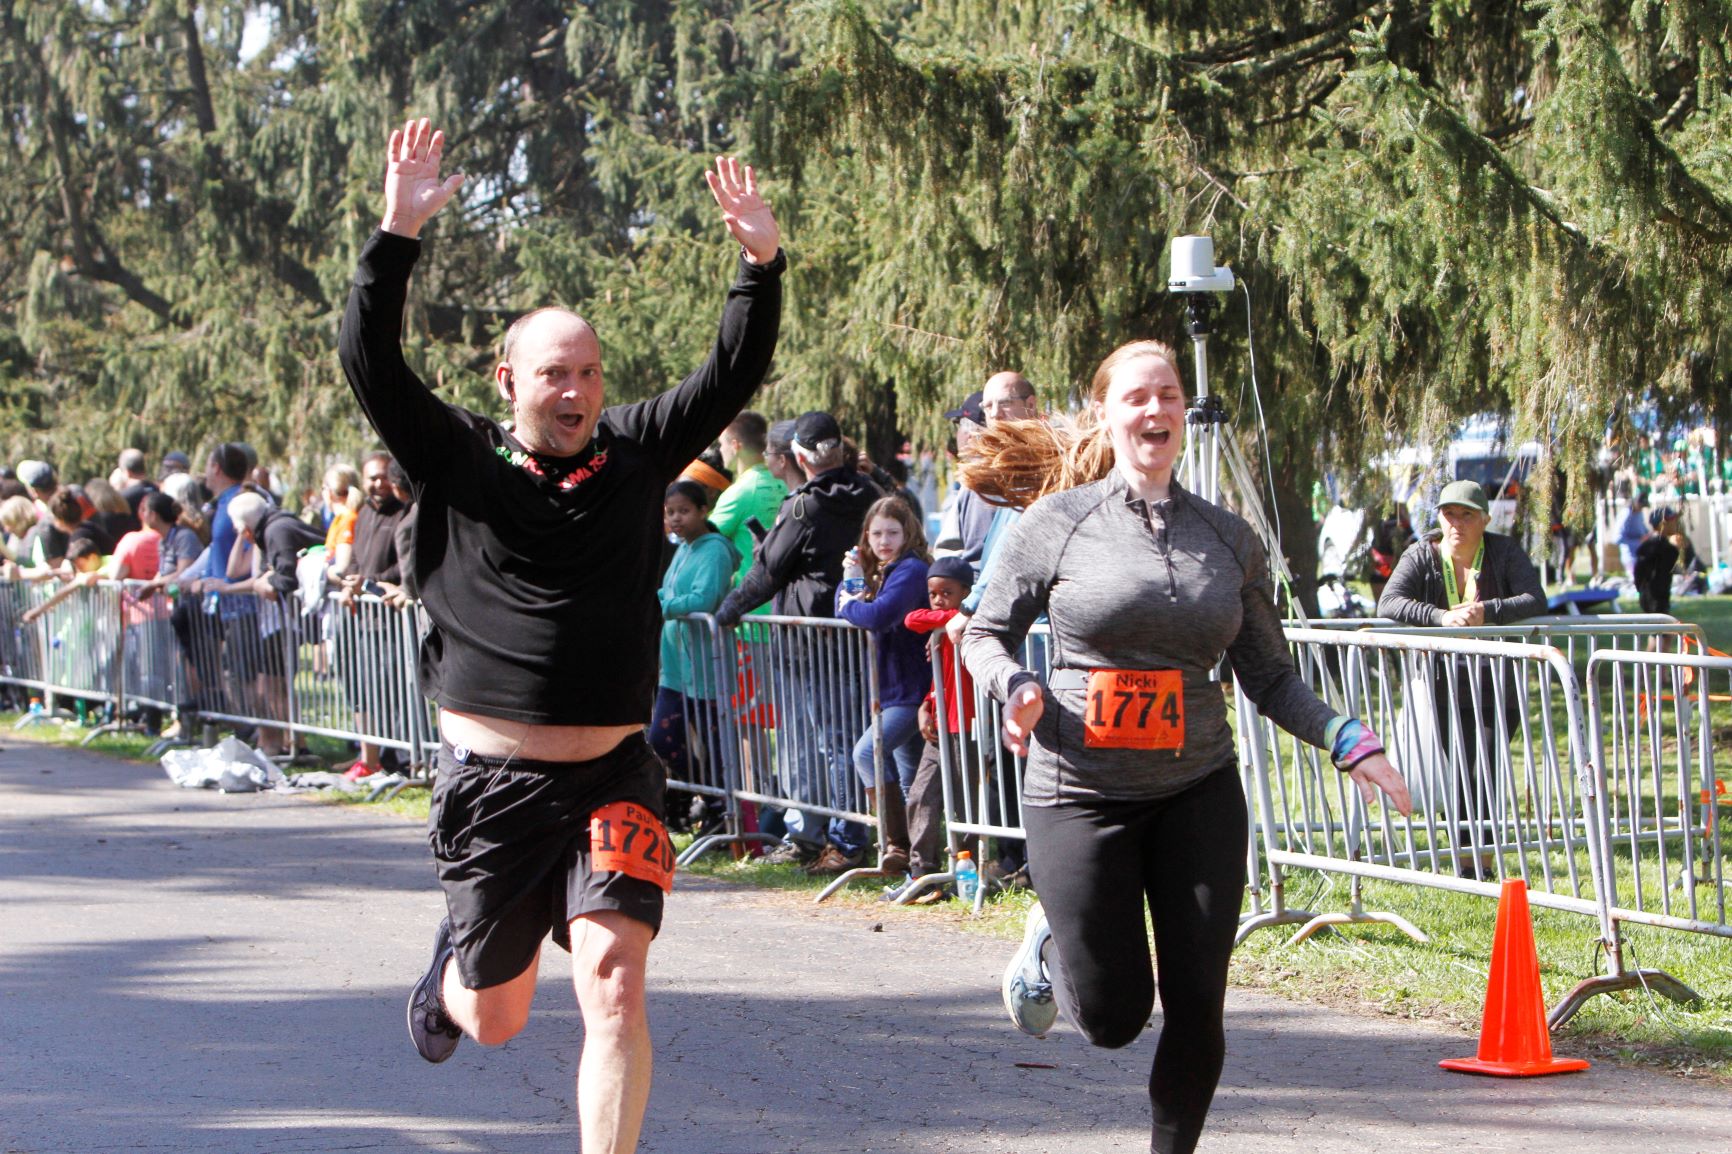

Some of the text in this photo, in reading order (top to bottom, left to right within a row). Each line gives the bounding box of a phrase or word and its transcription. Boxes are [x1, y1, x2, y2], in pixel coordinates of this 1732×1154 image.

[1116, 674, 1157, 688] Nicki
[1090, 690, 1180, 728] 1774
[598, 819, 673, 873] 1720
